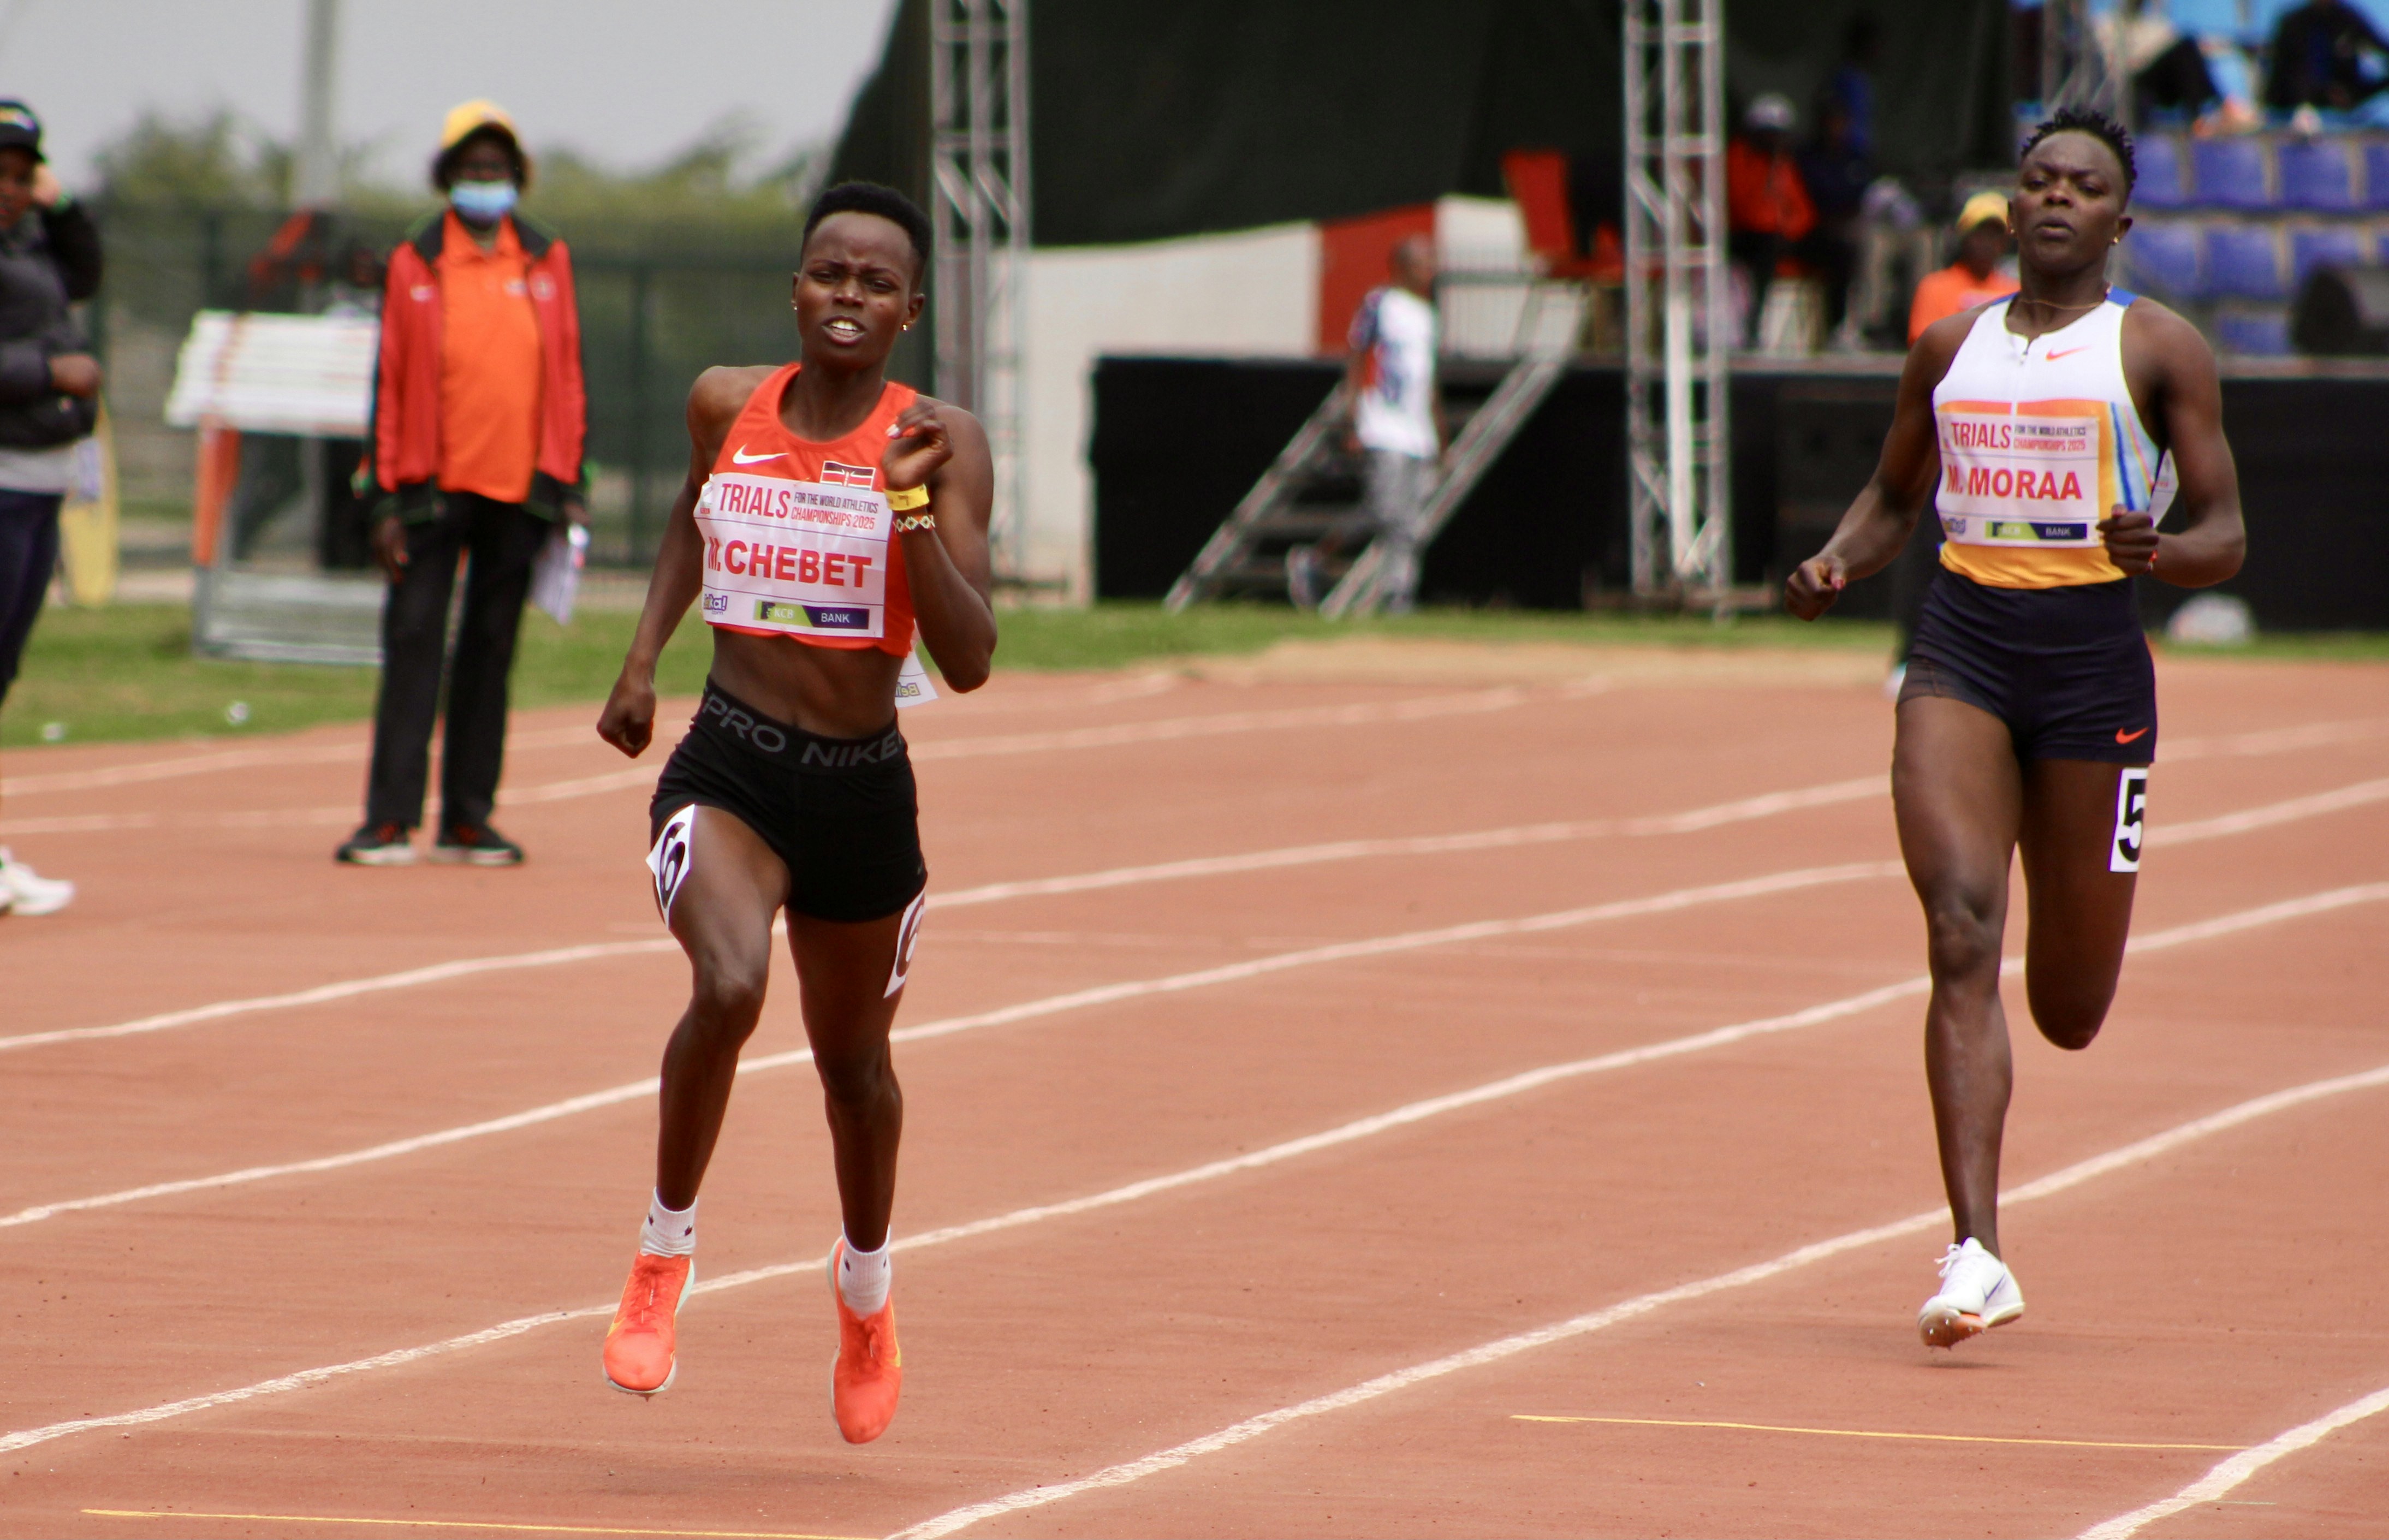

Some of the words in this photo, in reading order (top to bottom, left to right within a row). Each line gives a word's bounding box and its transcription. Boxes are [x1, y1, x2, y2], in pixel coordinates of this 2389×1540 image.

[1951, 422, 2011, 449] TRIALS
[1969, 467, 2082, 500] MORAA
[720, 483, 791, 519] TRIALS
[794, 492, 806, 504] FOR
[807, 493, 818, 506] THE
[819, 495, 841, 508] WORLD
[842, 498, 878, 514] ATHLETICS
[791, 507, 852, 526] CHAMPIONSHIPS
[852, 515, 876, 530] 2025
[2046, 527, 2071, 537] BANK
[724, 540, 872, 588] CHEBET
[774, 609, 794, 619] KCB
[821, 613, 850, 623] BANK
[702, 693, 786, 753] PRO
[800, 730, 899, 767] NIKE
[2118, 778, 2147, 862] 5
[659, 822, 686, 909] 6
